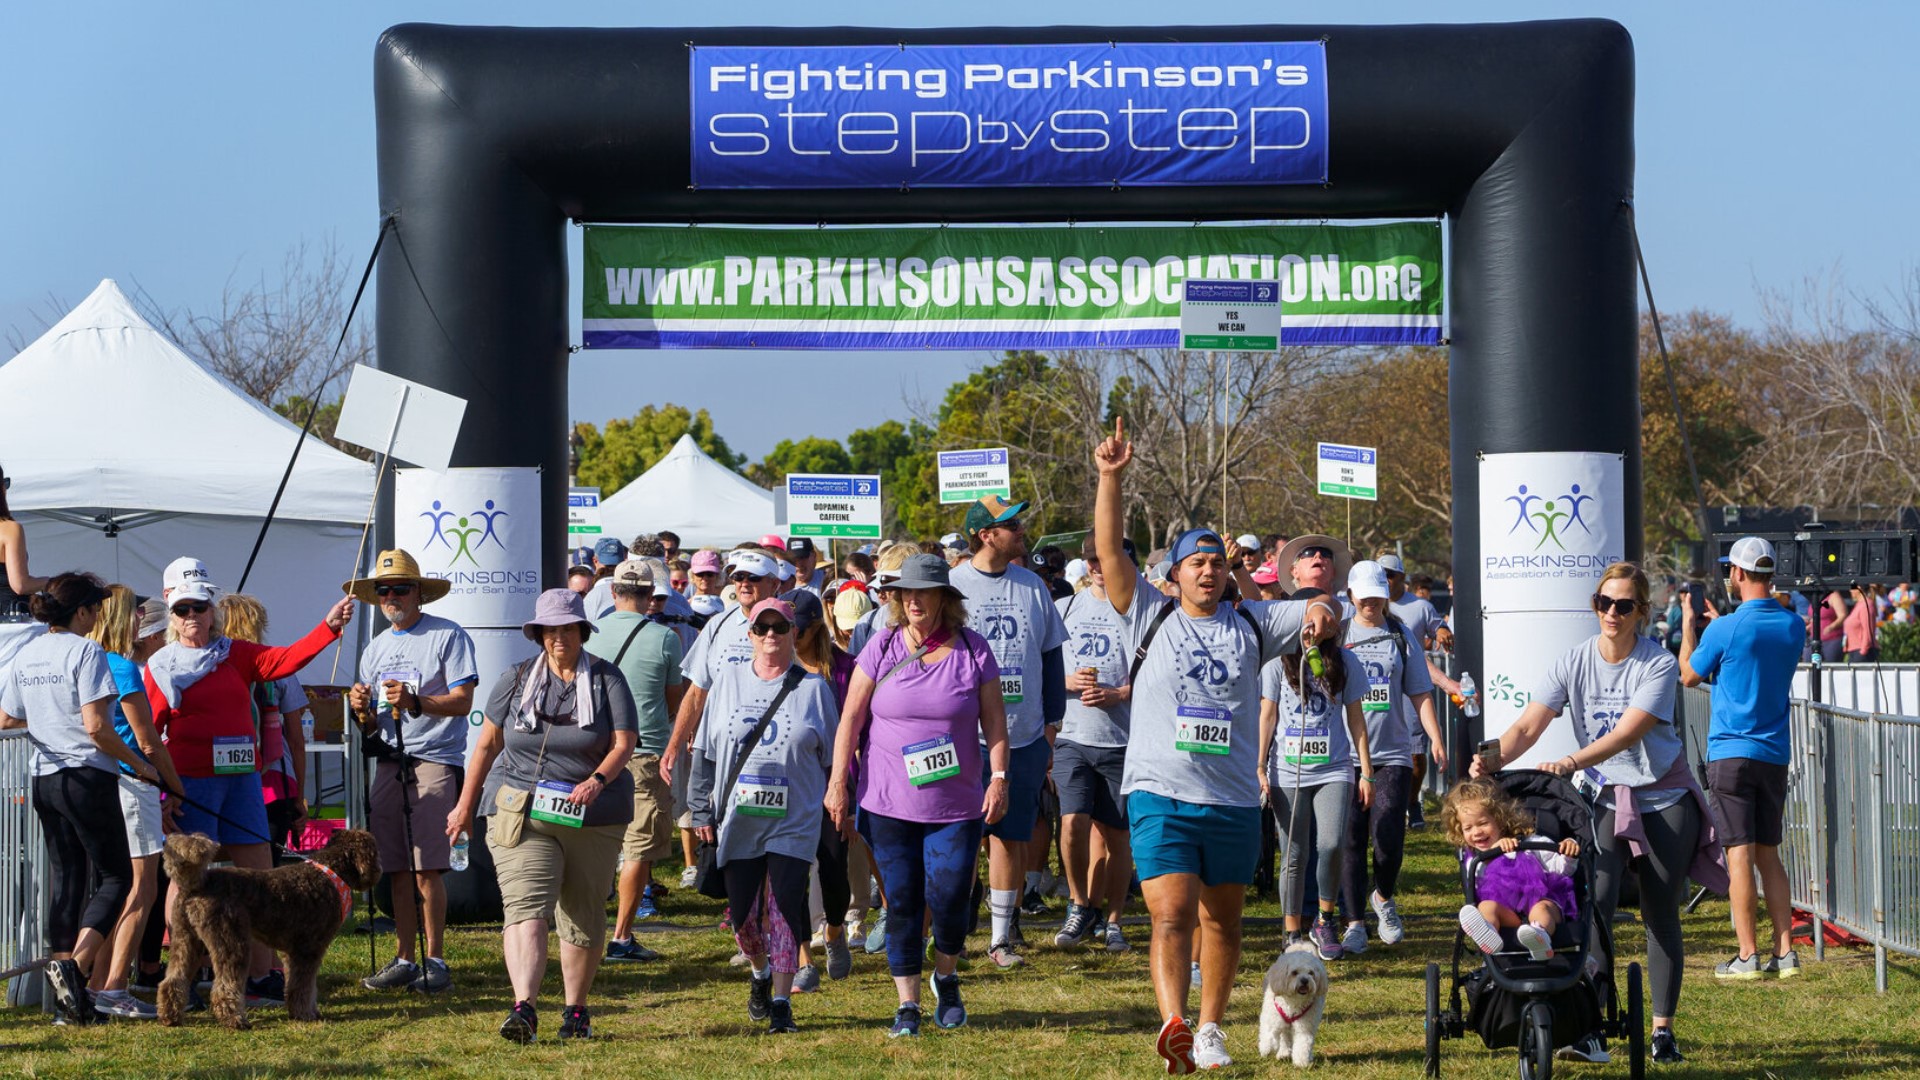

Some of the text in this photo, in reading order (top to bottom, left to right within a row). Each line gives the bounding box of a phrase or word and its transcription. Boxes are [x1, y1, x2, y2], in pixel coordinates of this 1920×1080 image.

[710, 59, 1309, 100] Fighting Parkinson's
[1225, 311, 1239, 320] YES
[1218, 323, 1245, 332] WE CAN
[979, 479, 1004, 487] TOGETHER
[814, 503, 848, 511] DOPAMINE
[819, 513, 850, 521] CAFFEINE
[426, 570, 537, 584] KINSON'S
[1486, 570, 1551, 580] Association
[1553, 570, 1563, 578] of
[1568, 569, 1590, 579] San
[466, 585, 477, 594] of
[482, 585, 504, 594] San
[508, 585, 537, 595] Diego
[985, 614, 1018, 641] 20
[1078, 632, 1111, 657] 20
[1186, 649, 1228, 686] 20
[1001, 681, 1021, 693] 485
[1194, 725, 1228, 743] 1824
[1298, 741, 1327, 754] 493
[227, 749, 254, 763] 1629
[923, 750, 953, 770] 1737
[753, 791, 784, 806] 1724
[551, 797, 582, 816] 1738
